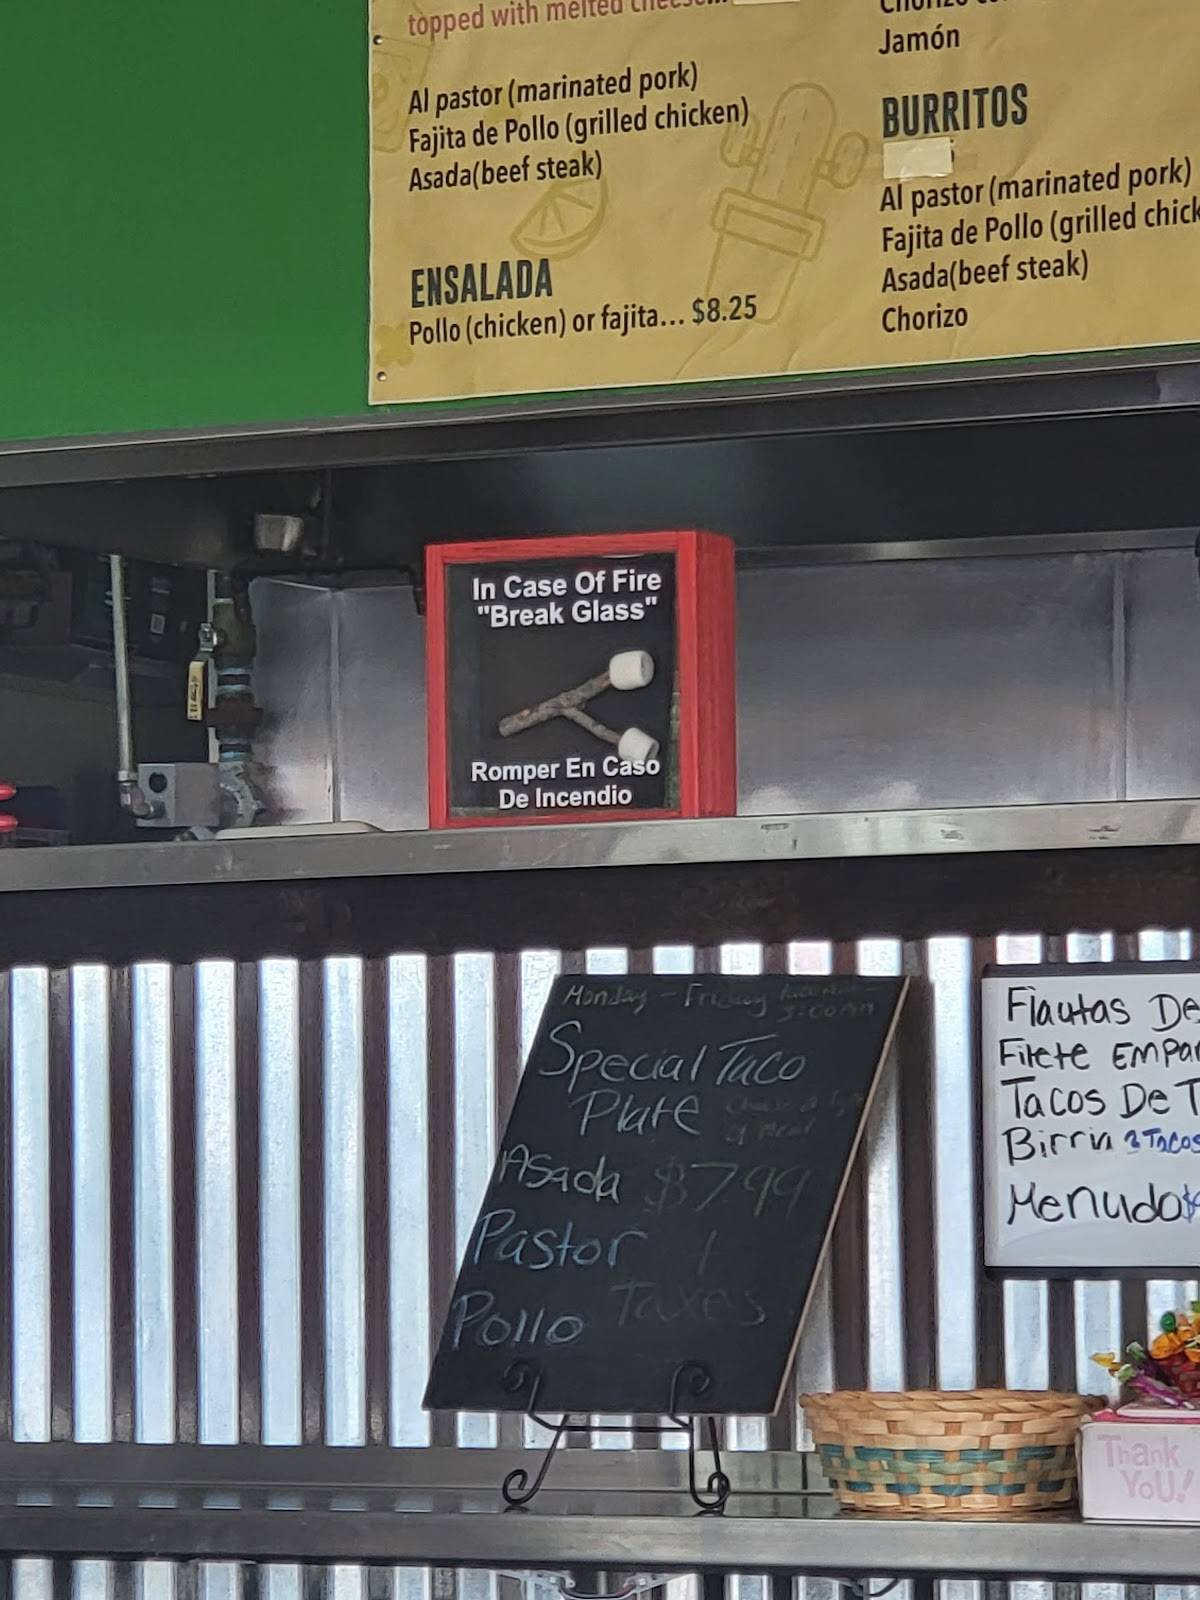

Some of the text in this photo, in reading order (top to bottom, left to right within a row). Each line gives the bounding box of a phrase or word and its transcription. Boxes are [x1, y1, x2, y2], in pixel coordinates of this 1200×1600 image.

[408, 4, 484, 41] topped
[491, 0, 538, 27] with
[878, 23, 960, 54] Jamón
[408, 60, 698, 118] Al pastor (marinated pork)
[882, 83, 1028, 138] BURRITOS
[409, 96, 749, 158] Fajita de Pollo (grilled chicken)
[409, 149, 602, 191] Asada(beef steak)
[880, 156, 1191, 217] Al pastor (marinated pork)
[882, 224, 943, 258] Fajita
[951, 219, 977, 246] de
[986, 212, 1043, 243] Pollo
[1050, 202, 1136, 243] (grilled
[411, 258, 553, 308] ENSALADA
[882, 249, 1088, 293] Asada(beef steak)
[410, 316, 460, 345] Pollo
[466, 308, 565, 345] (chicken)
[573, 310, 596, 333] or
[692, 294, 757, 326] $8.25
[882, 303, 968, 333] Chorizo
[473, 569, 662, 601] In Case Of Fire
[477, 595, 658, 629] "Break Glass"
[471, 755, 661, 785] Romper En Caso
[499, 785, 633, 811] De Incendio
[1007, 986, 1131, 1028] Flautas
[537, 1020, 806, 1094] Special Taco
[568, 1090, 702, 1136] Plate
[1001, 1075, 1106, 1119] Tacos
[1120, 1082, 1170, 1119] De
[1002, 1126, 1113, 1166] Birria
[499, 1144, 621, 1204] Asada
[1007, 1181, 1182, 1226] Menudo
[470, 1208, 649, 1271] Pastor
[449, 1290, 584, 1351] Pollo
[1096, 1433, 1181, 1469] Thank
